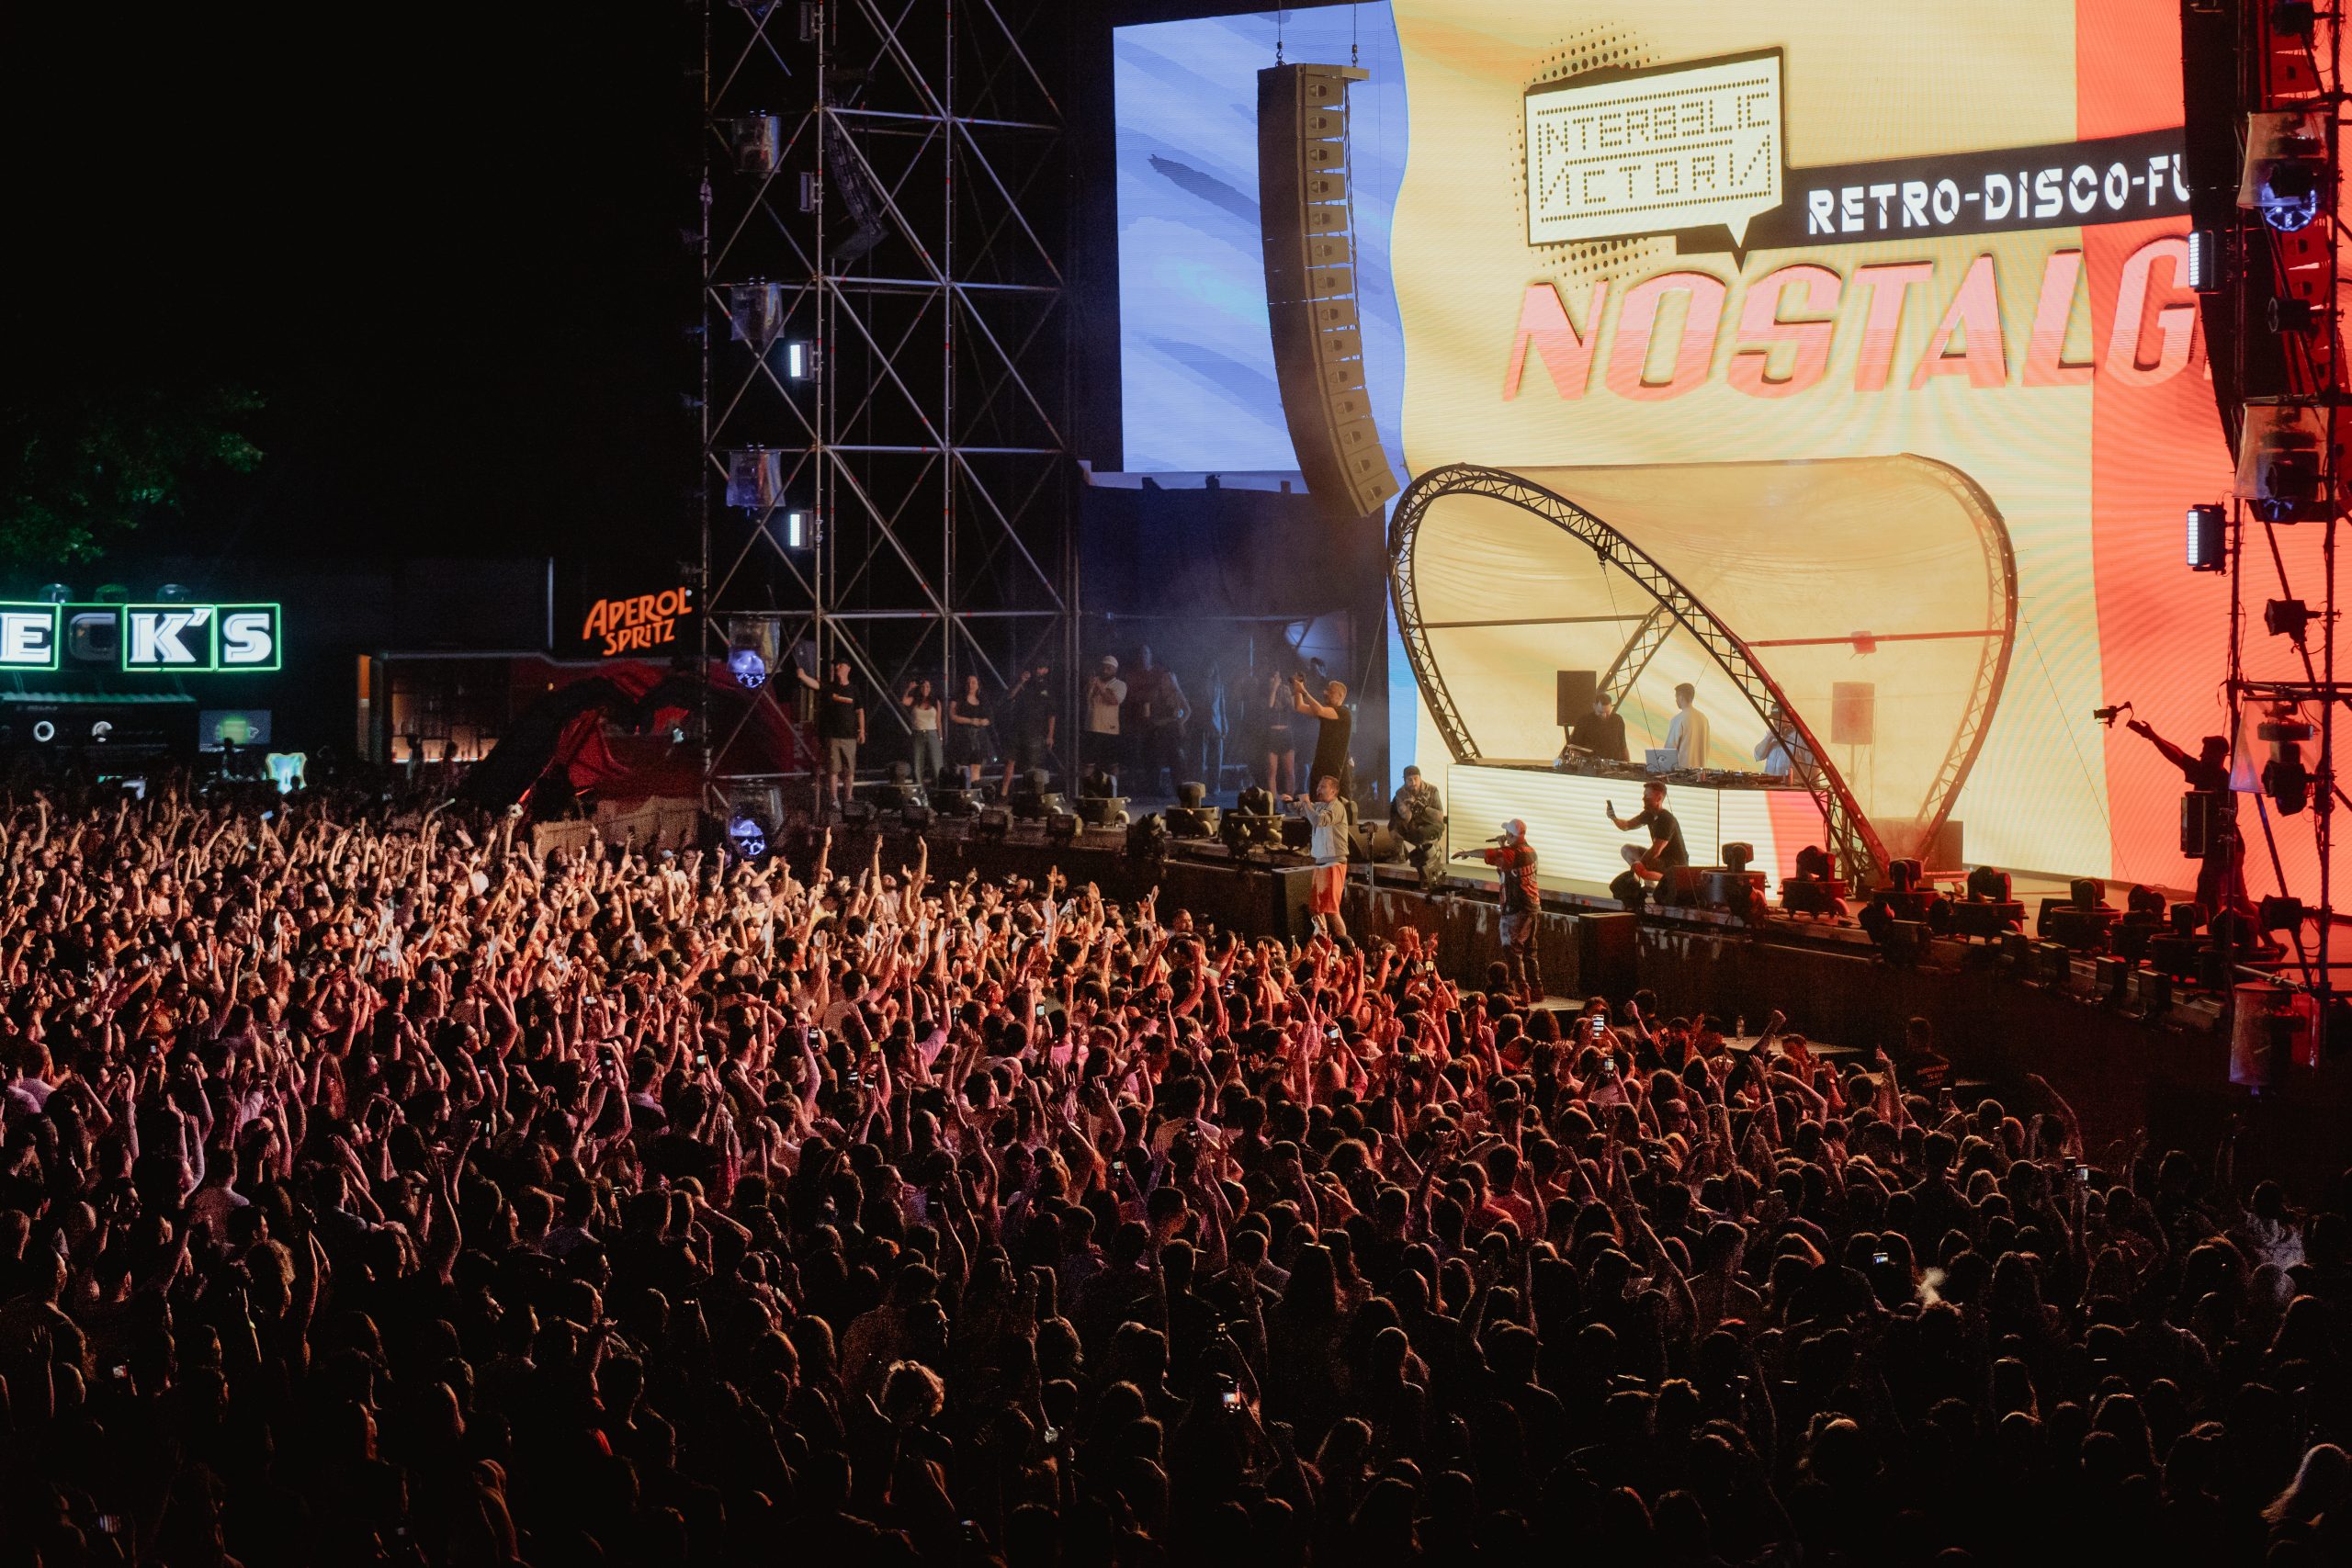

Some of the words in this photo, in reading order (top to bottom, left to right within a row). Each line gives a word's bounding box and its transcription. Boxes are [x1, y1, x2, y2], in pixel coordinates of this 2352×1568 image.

[1807, 153, 2190, 235] RETRO-DISCO-FU
[1504, 236, 2197, 402] NOSTALG
[582, 586, 693, 640] APEROL
